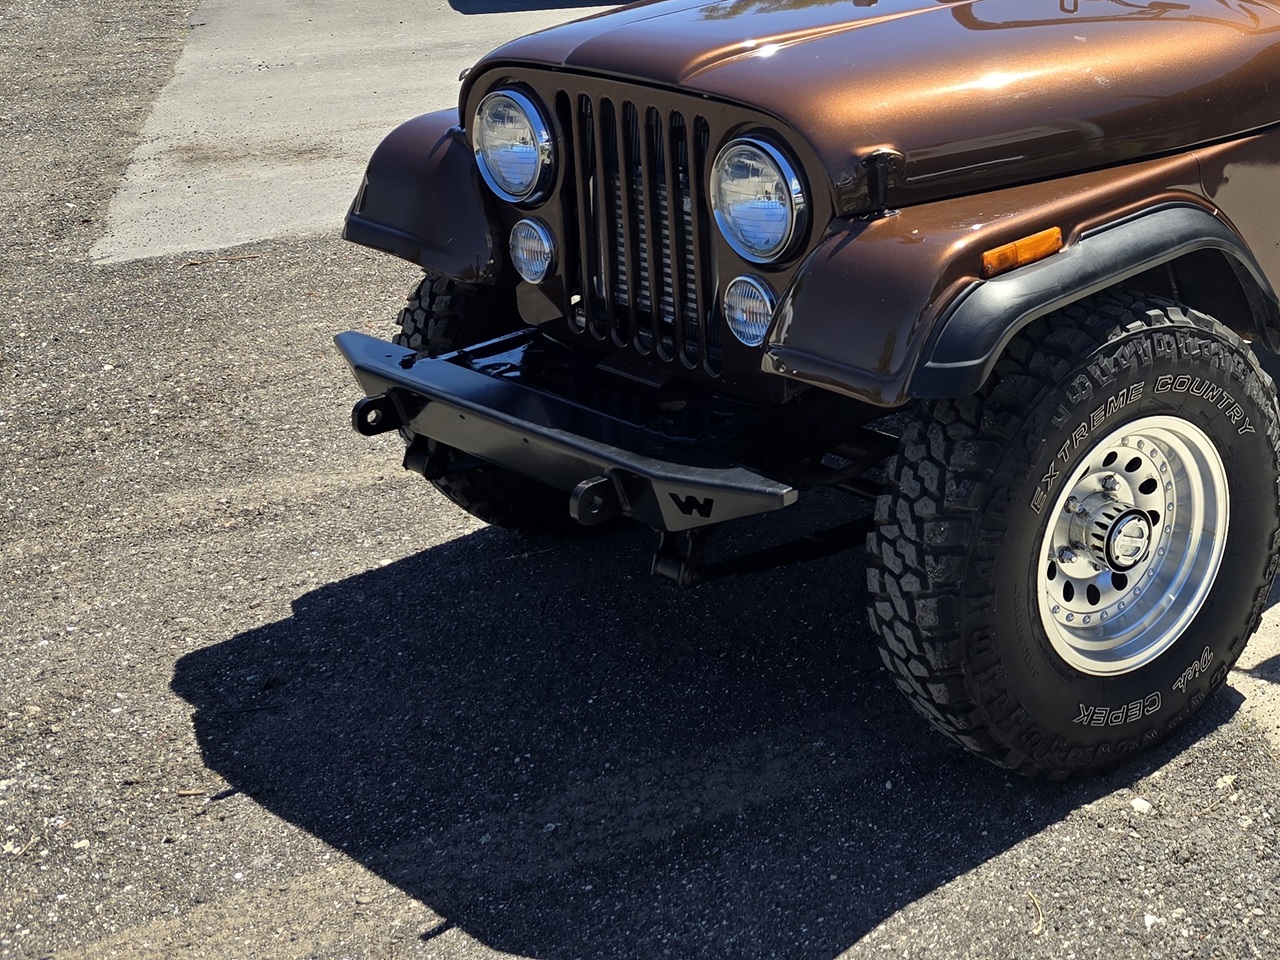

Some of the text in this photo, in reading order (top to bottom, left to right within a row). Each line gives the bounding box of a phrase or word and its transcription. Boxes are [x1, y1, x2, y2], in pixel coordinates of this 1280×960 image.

[1030, 374, 1256, 514] EXTREME COUNTRY
[1072, 691, 1162, 727] CEPEK
